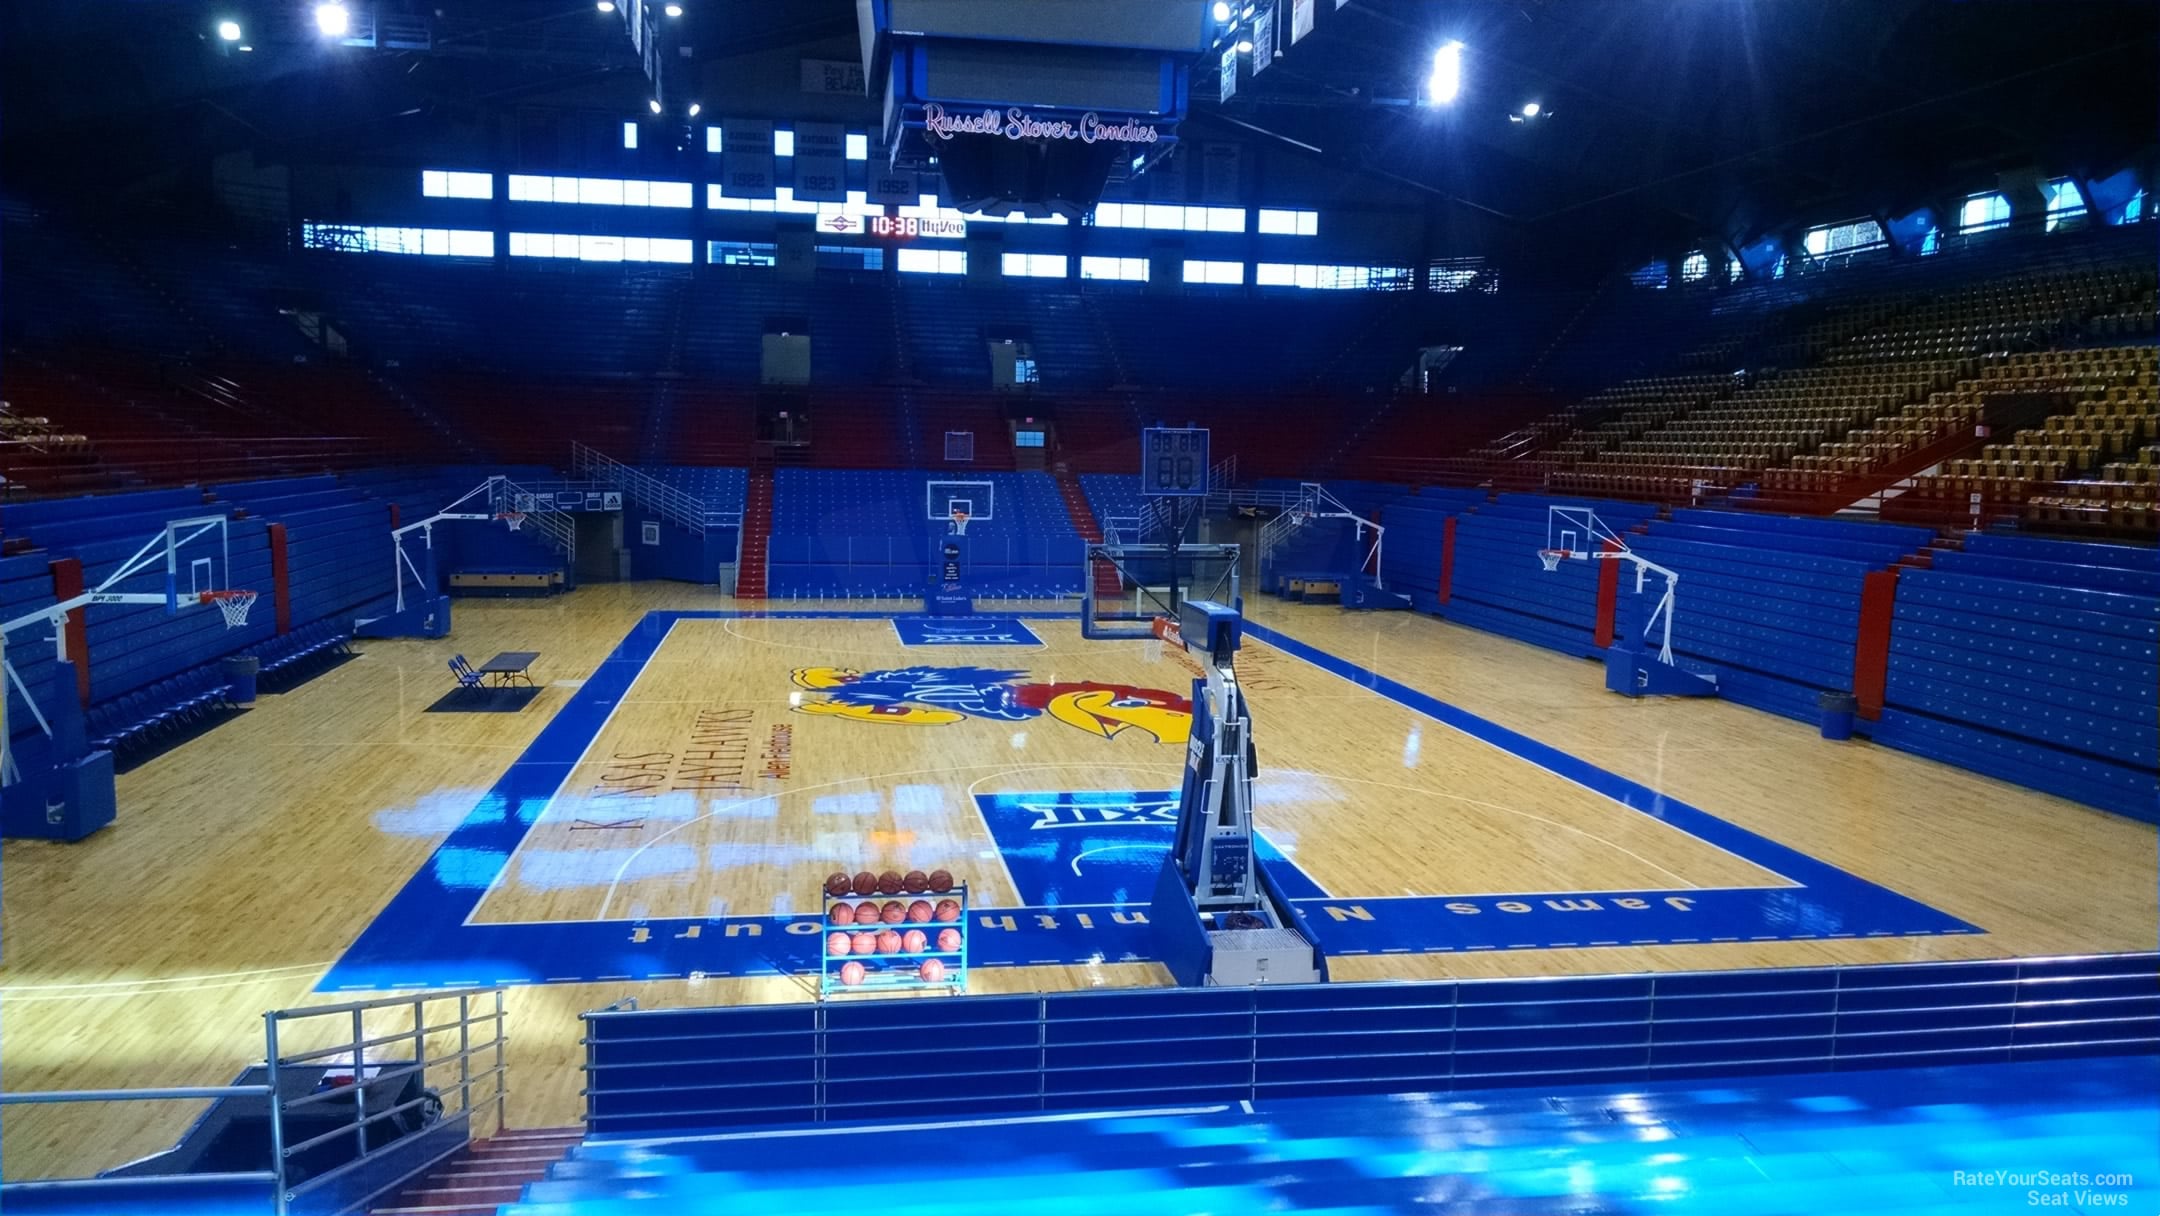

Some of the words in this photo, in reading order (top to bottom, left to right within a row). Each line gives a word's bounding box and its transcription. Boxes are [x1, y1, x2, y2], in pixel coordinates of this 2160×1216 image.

[922, 103, 1003, 140] Russell
[1004, 107, 1079, 140] Stover
[1079, 111, 1159, 144] Candies
[732, 173, 766, 188] 1922
[804, 176, 837, 191] 1923
[872, 216, 918, 235] 10:38
[672, 709, 755, 791] JAYHAWKS
[1444, 896, 1697, 916] James
[632, 921, 892, 944] ourt
